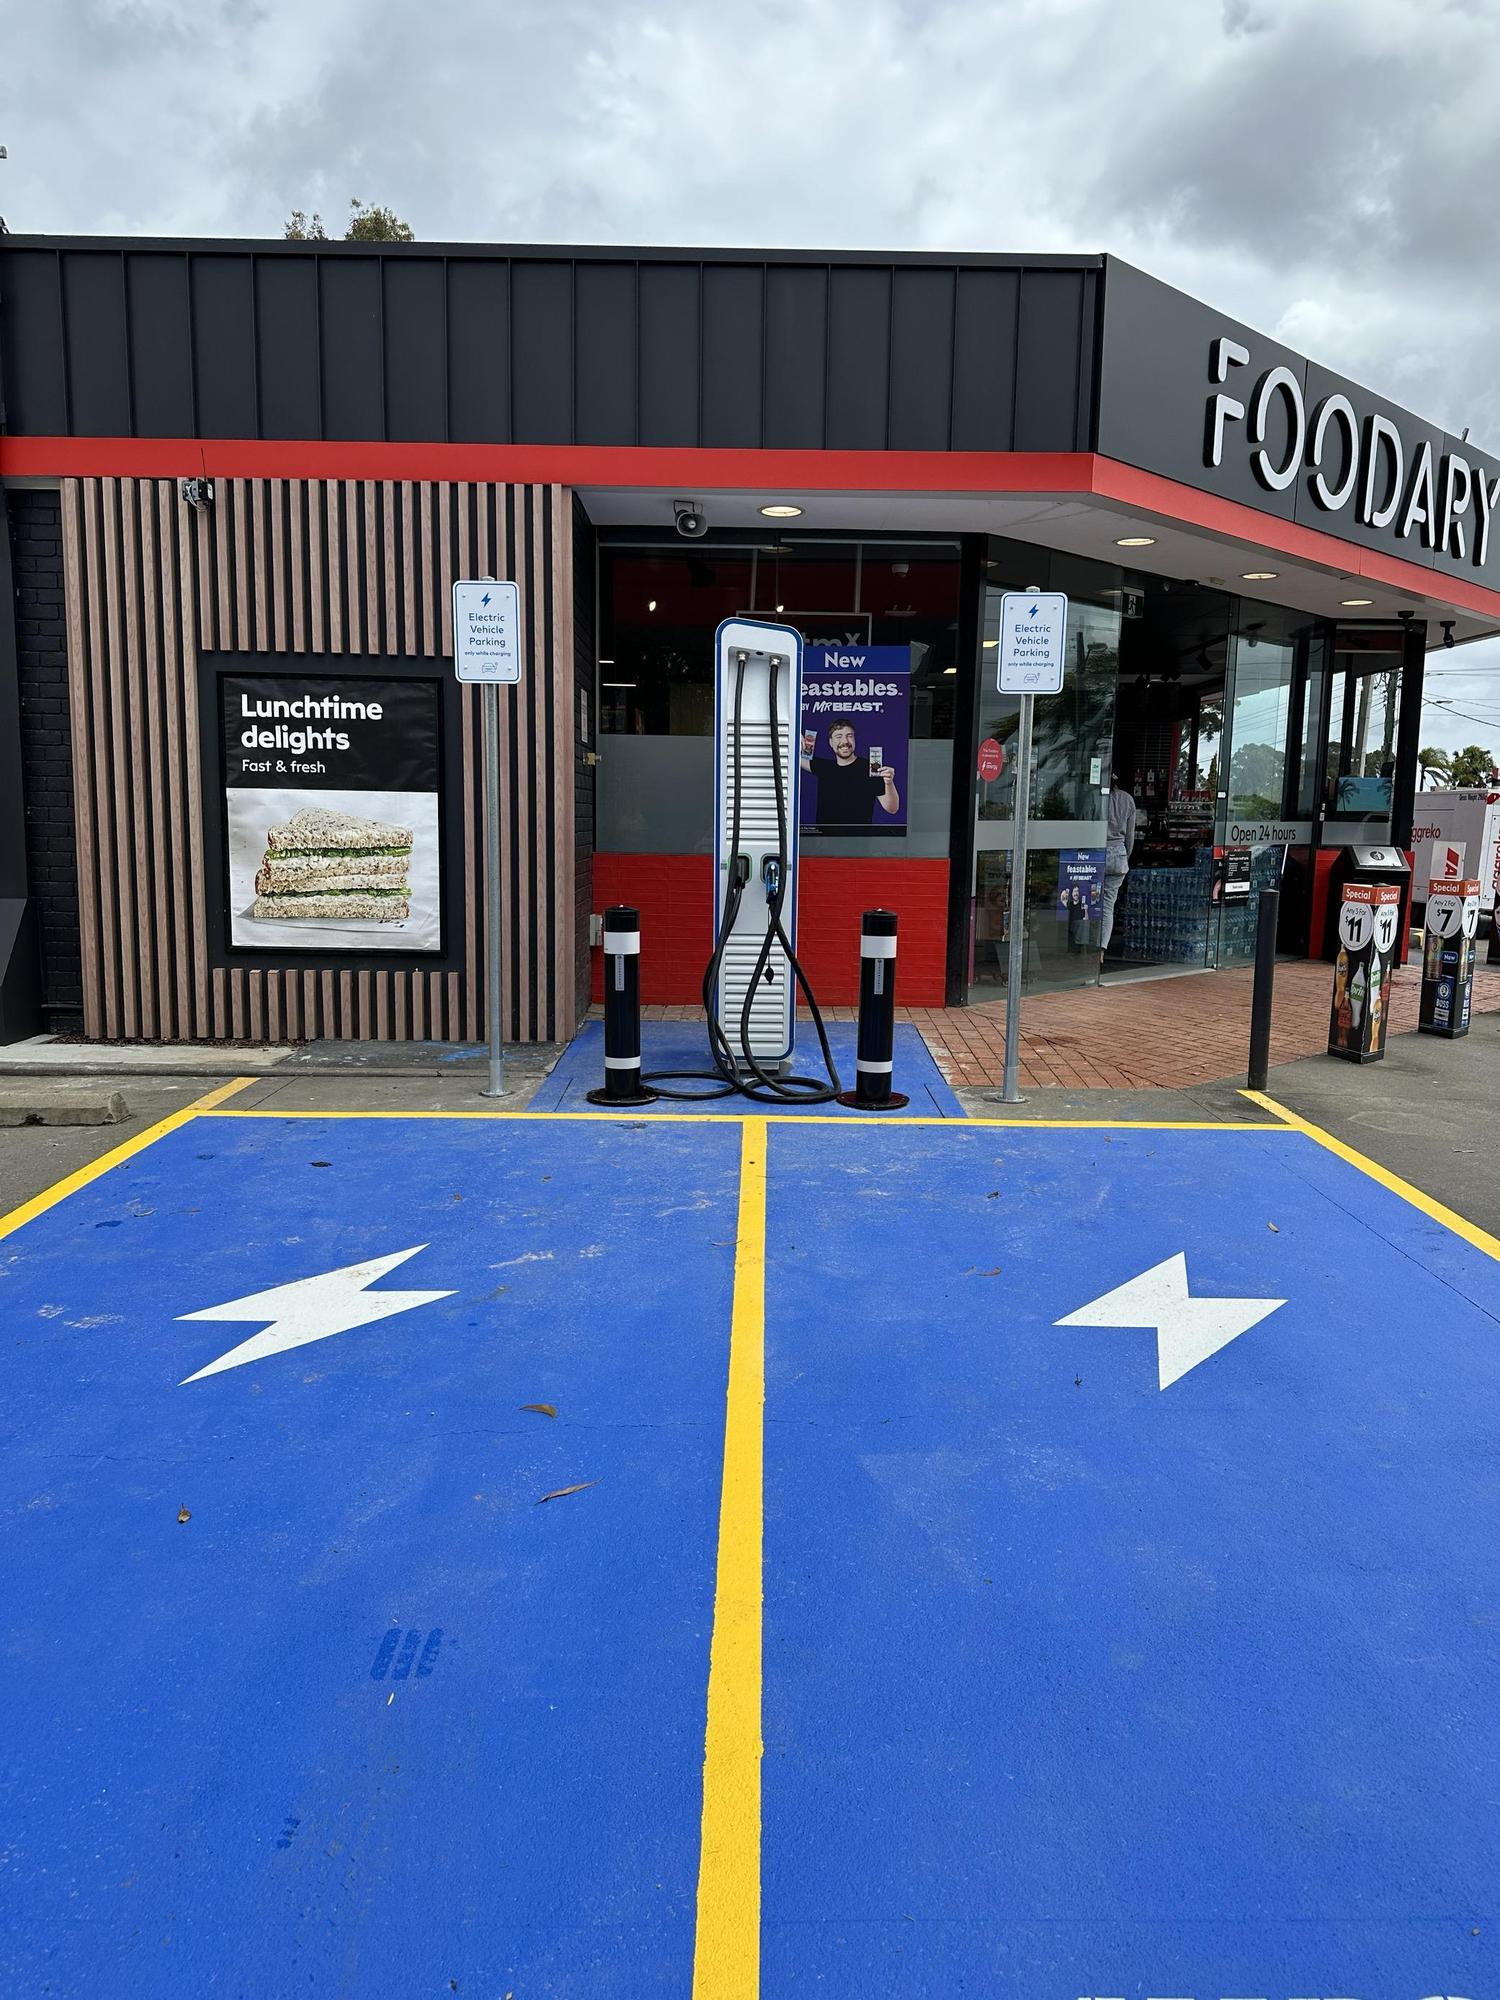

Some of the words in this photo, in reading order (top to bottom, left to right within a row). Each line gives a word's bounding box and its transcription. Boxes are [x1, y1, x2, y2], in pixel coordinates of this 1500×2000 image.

[1206, 336, 1500, 566] FOODARY
[468, 612, 505, 622] Electric
[470, 625, 504, 634] Vehicle
[1014, 624, 1051, 633] Electric
[469, 637, 506, 648] Parking
[1015, 636, 1049, 645] Vehicle
[1013, 648, 1050, 658] Parking
[824, 651, 866, 668] New
[801, 679, 899, 696] eastables
[241, 693, 383, 720] Lunchtime
[241, 724, 350, 755] delights
[242, 759, 272, 772] Fast
[275, 759, 287, 773] &
[290, 760, 326, 773] fresh
[1231, 825, 1257, 845] Open
[1259, 825, 1270, 841] 24
[1272, 825, 1296, 840] hours
[1411, 822, 1441, 843] ggreko
[1346, 888, 1371, 900] Special
[1433, 883, 1460, 893] Special
[1381, 891, 1398, 902] Special
